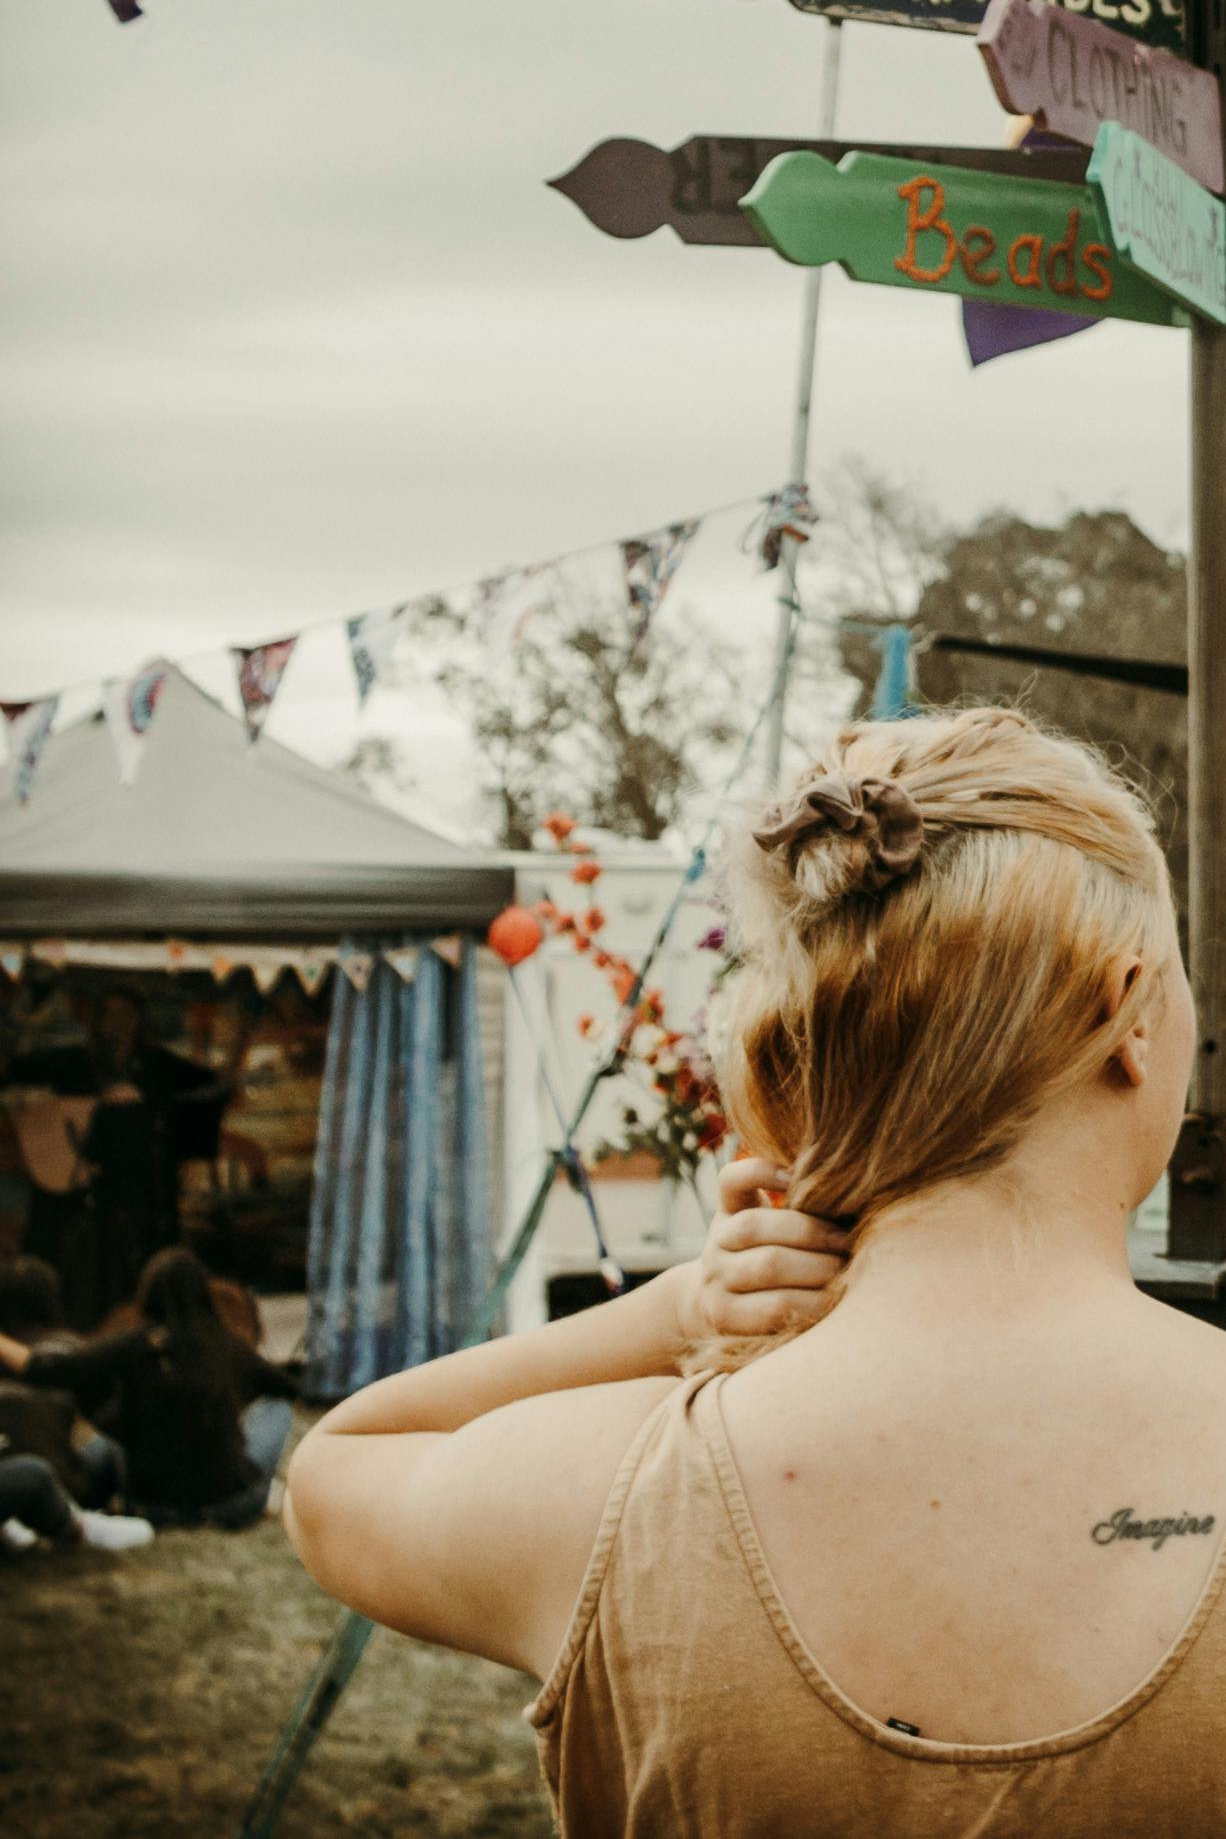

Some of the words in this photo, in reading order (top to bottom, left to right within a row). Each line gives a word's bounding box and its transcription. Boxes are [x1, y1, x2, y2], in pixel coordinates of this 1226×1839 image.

[1047, 19, 1189, 157] CLOTHING
[894, 175, 1114, 302] Beads
[1091, 1508, 1215, 1552] Imagine
